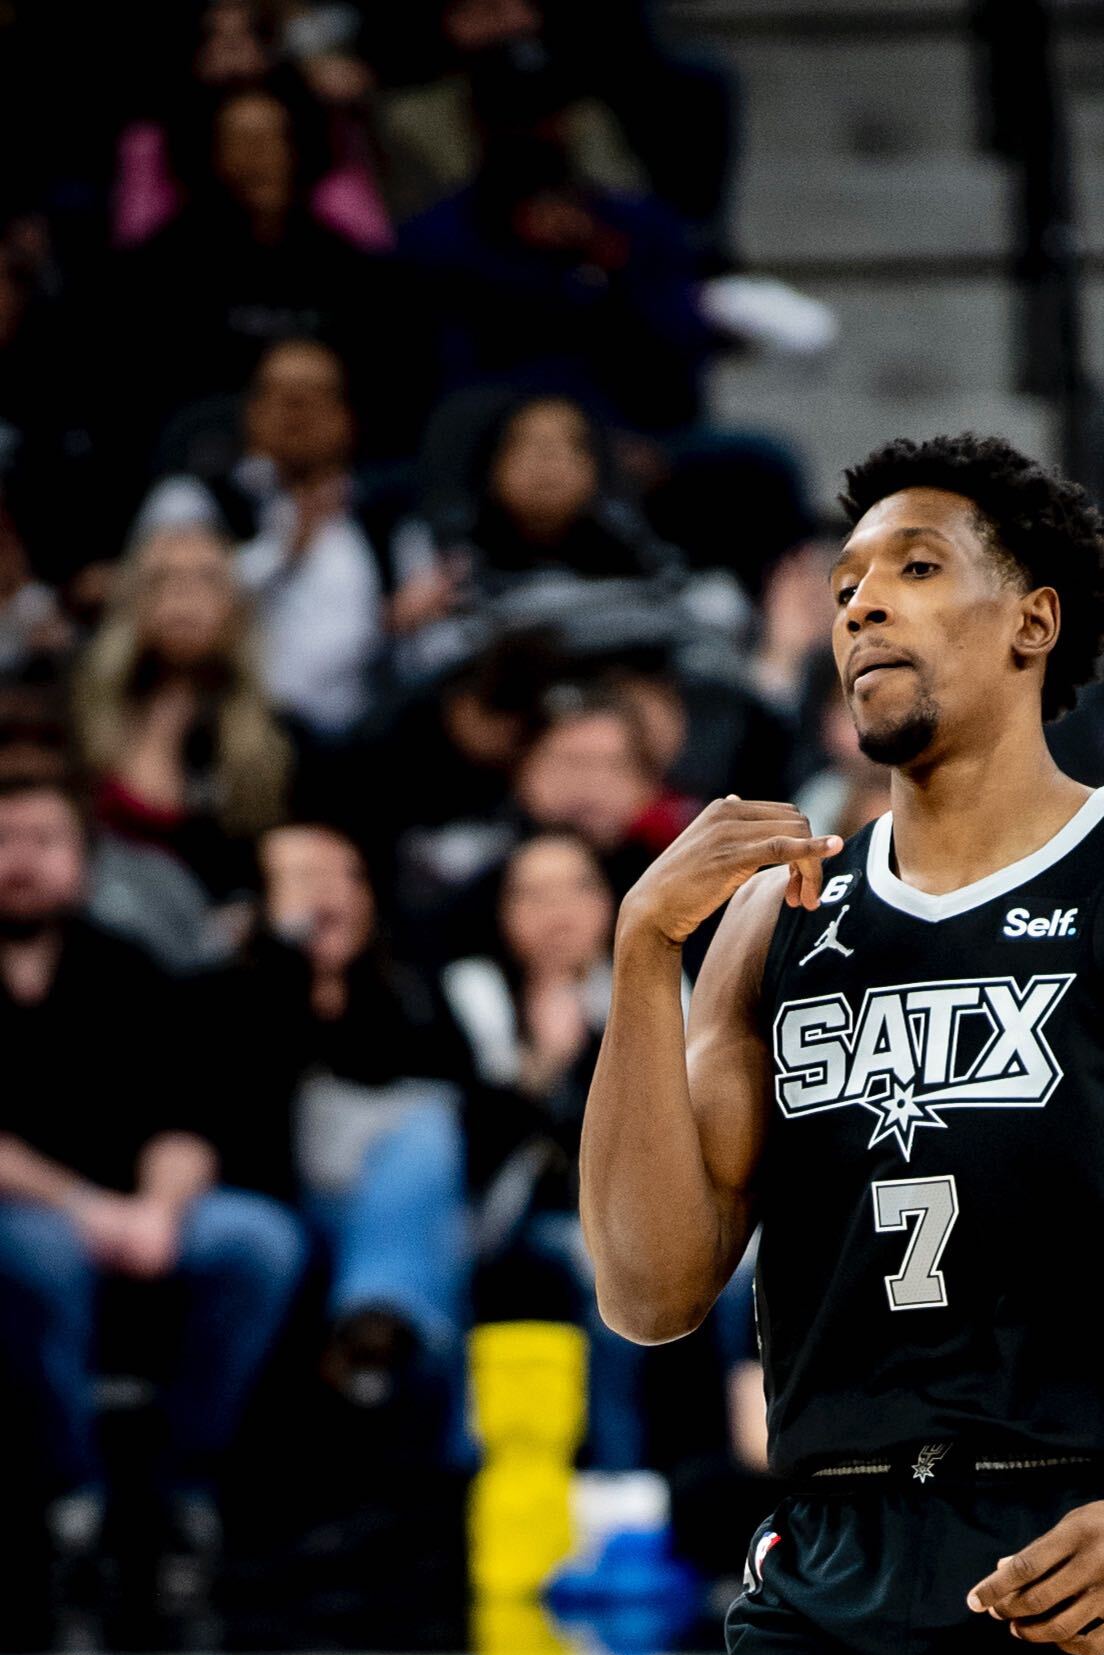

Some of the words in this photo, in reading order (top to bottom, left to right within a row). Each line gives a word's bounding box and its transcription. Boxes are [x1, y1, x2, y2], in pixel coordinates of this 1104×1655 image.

[820, 873, 853, 903] 6
[773, 973, 1077, 1119] SATX
[871, 1174, 959, 1311] 7
